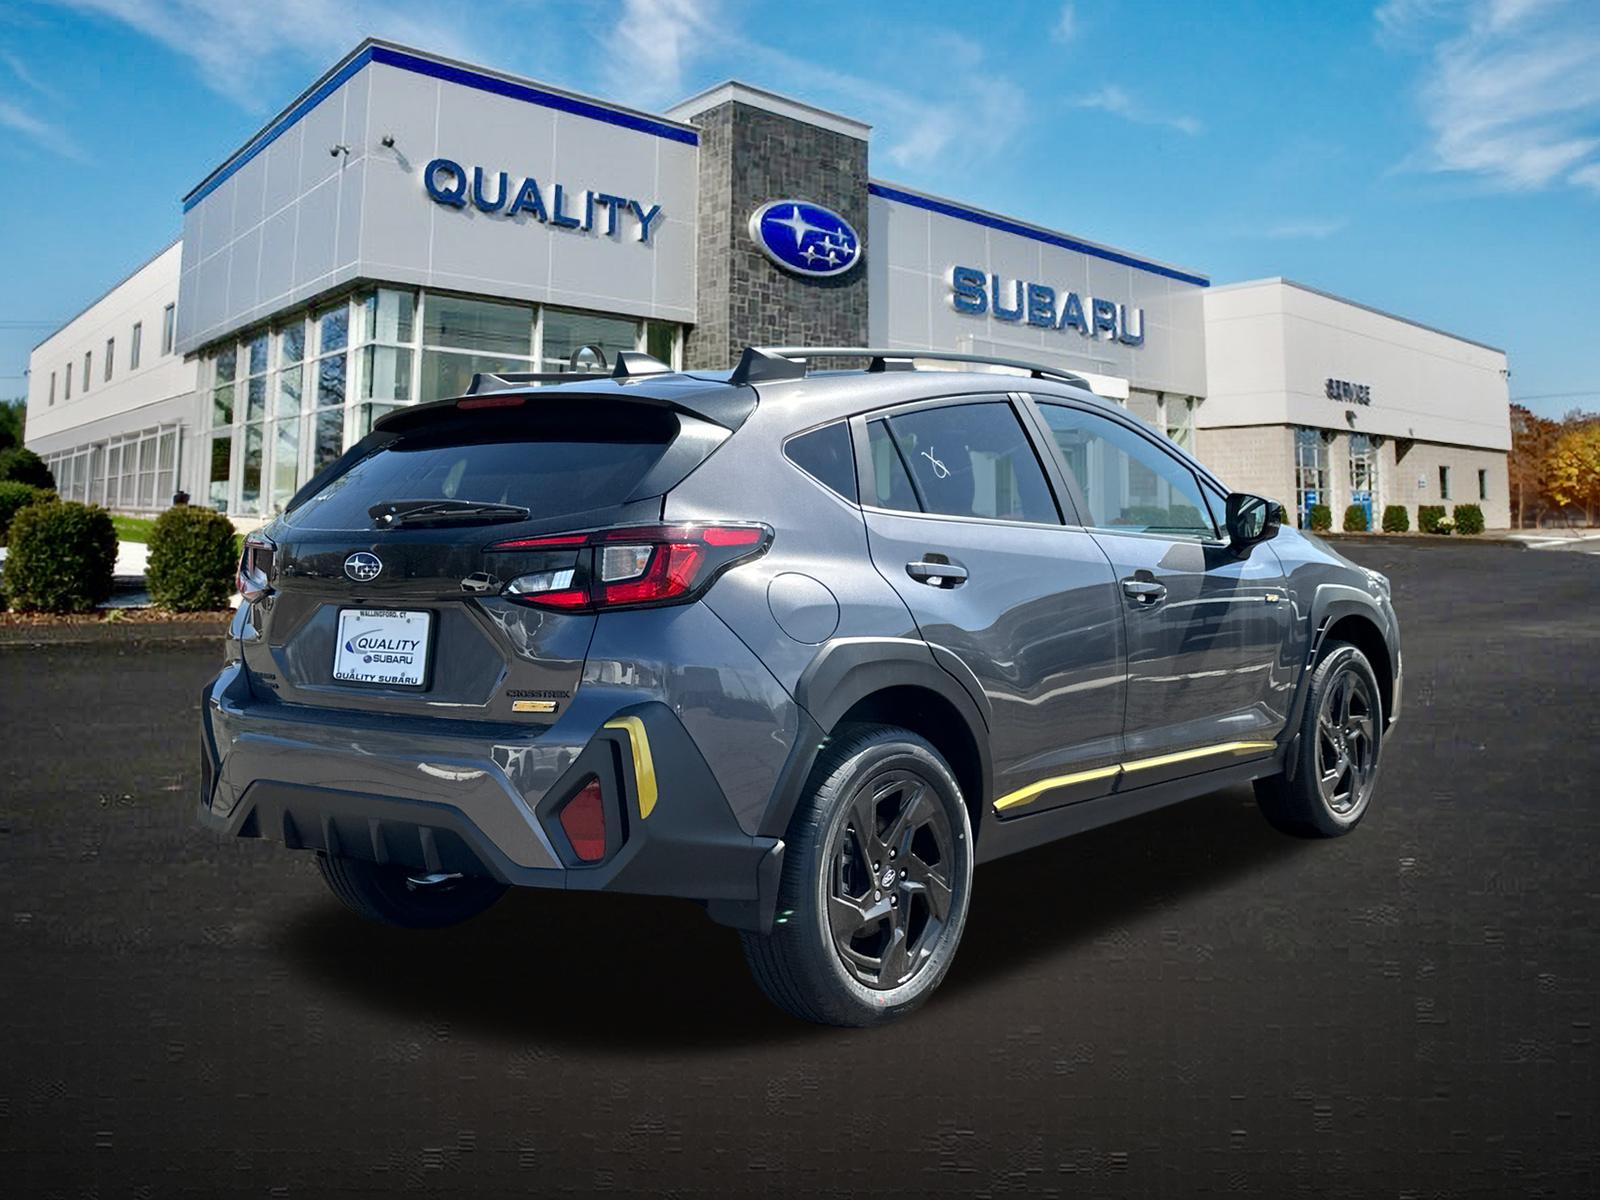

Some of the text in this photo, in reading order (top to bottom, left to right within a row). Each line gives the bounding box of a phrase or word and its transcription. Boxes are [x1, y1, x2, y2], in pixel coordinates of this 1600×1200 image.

[423, 157, 661, 243] QUALITY
[951, 265, 1145, 346] SUBARU
[358, 638, 420, 651] QUALITY
[373, 654, 413, 665] SUBARU
[336, 672, 418, 684] QUALITY SUBARU
